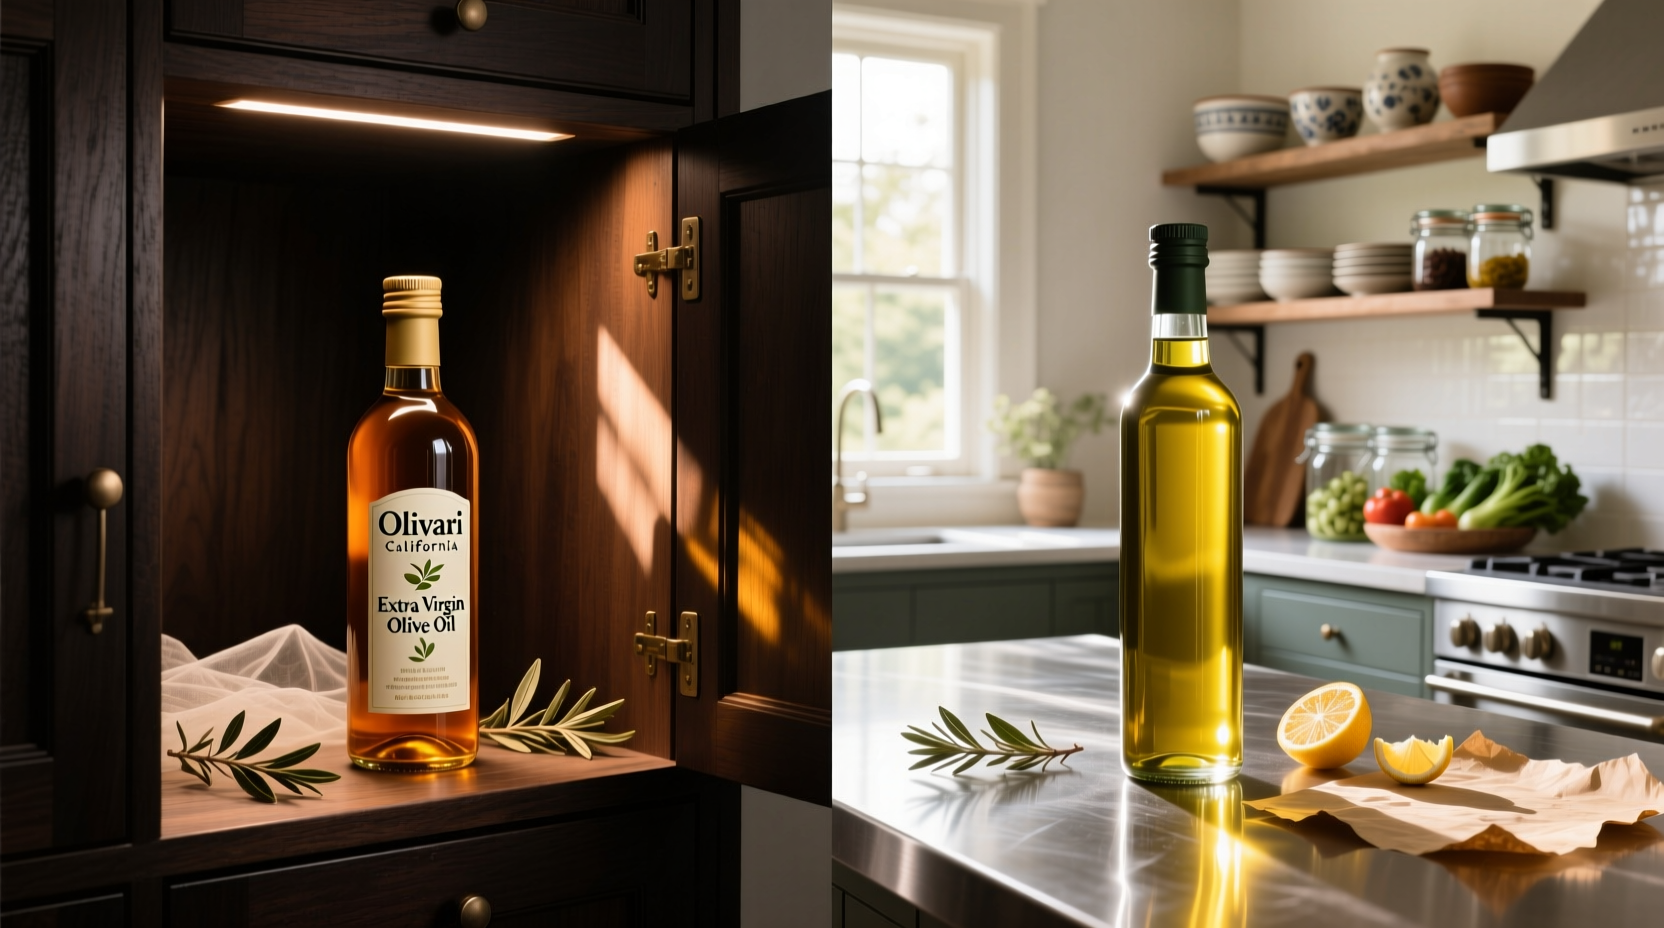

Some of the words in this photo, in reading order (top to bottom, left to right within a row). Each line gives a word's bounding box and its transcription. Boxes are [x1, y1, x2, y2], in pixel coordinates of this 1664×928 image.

[378, 510, 463, 536] Olivari
[377, 596, 420, 613] Extra
[422, 595, 465, 616] Virgin
[387, 616, 430, 634] Olive
[433, 614, 456, 633] Oil
